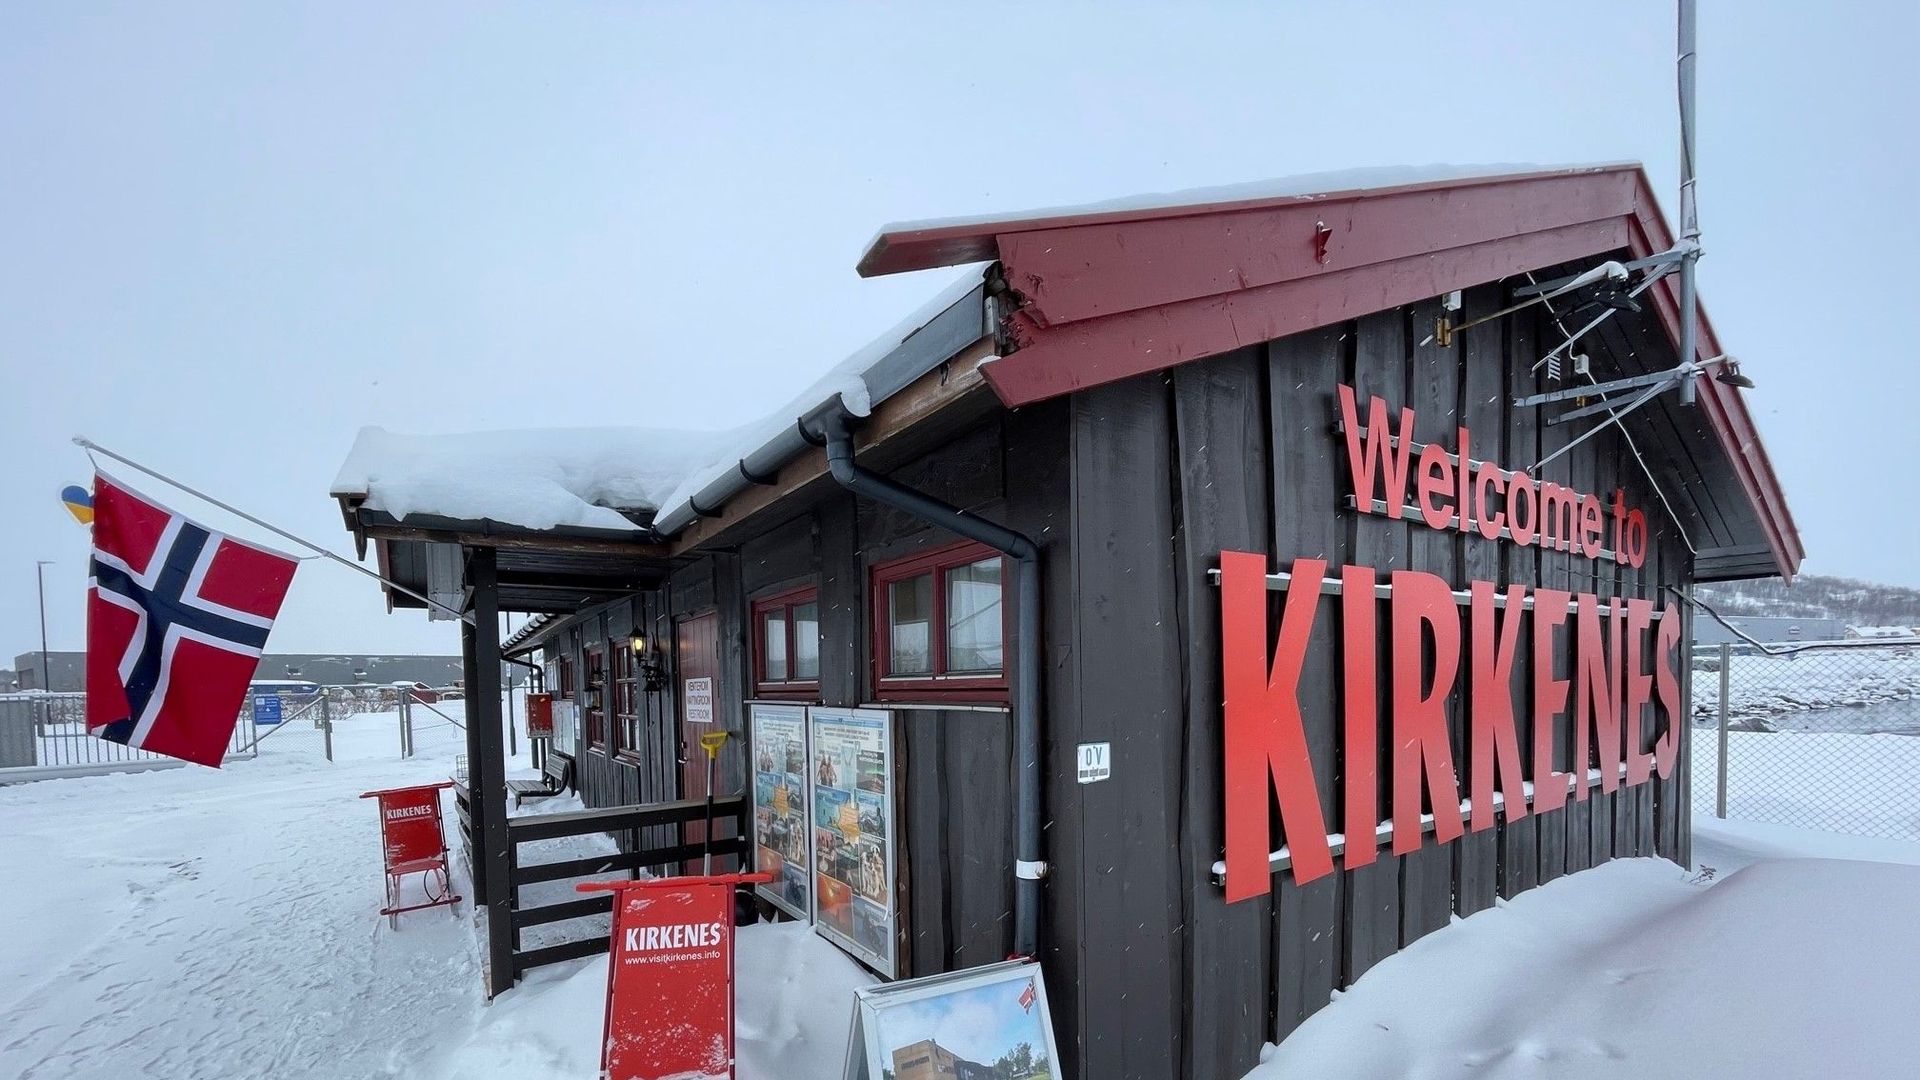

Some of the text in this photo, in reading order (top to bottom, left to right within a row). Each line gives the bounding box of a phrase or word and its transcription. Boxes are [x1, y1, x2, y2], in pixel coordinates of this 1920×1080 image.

[1338, 383, 1647, 569] Welcome to
[1220, 551, 1681, 904] KIRKENES
[386, 805, 432, 819] KIRKENES
[625, 922, 721, 951] KIRKENES
[625, 950, 721, 965] www.visitkirkenes.info
